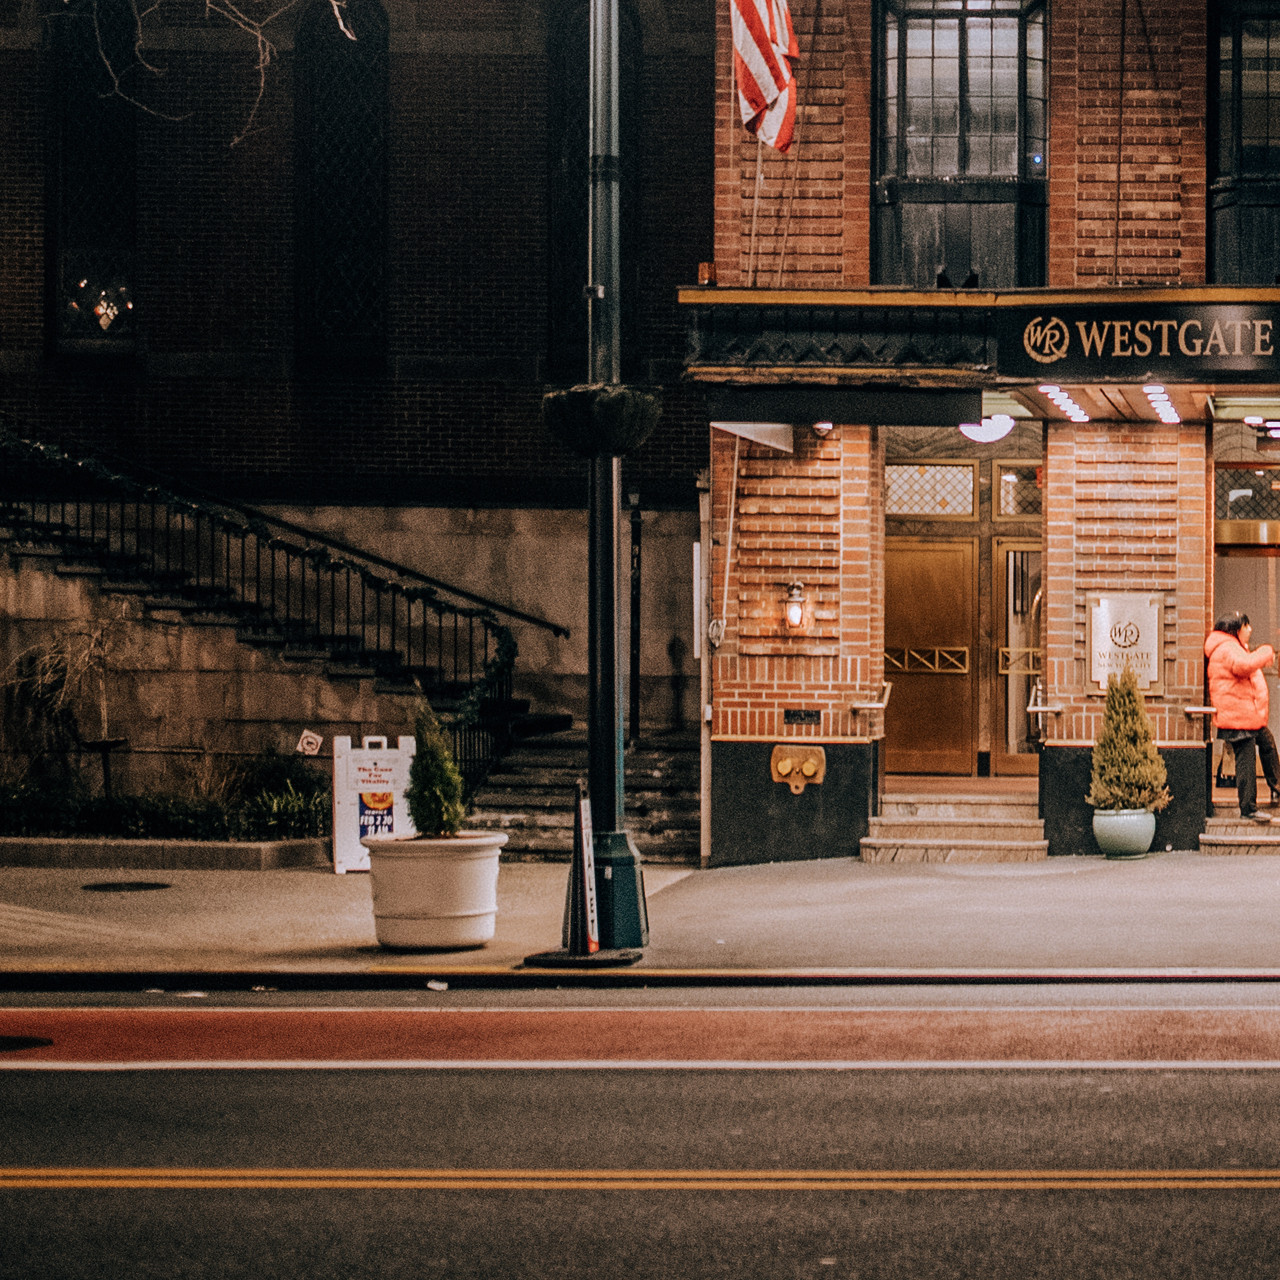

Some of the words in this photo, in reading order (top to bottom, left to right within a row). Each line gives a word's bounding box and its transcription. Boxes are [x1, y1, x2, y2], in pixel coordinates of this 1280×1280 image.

[1075, 320, 1274, 358] WESTGATE
[360, 815, 375, 826] FEB
[583, 831, 596, 937] VALET
